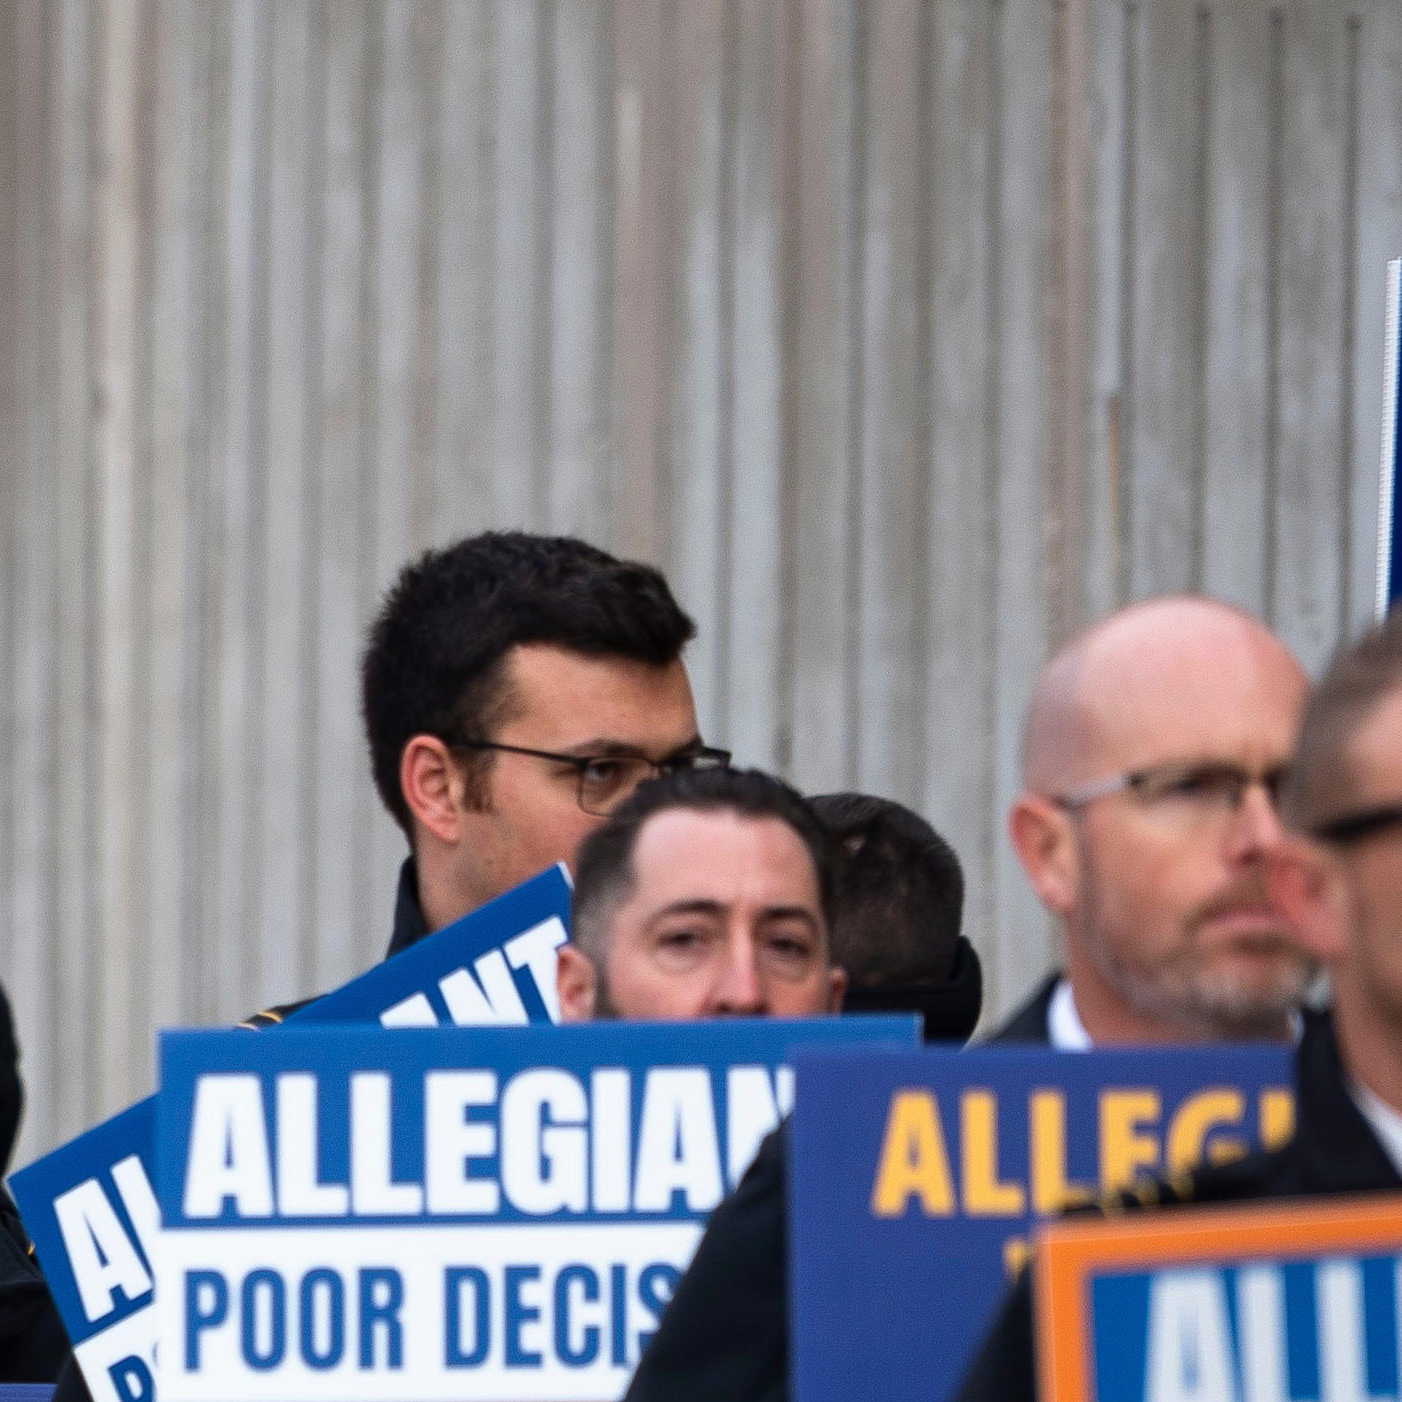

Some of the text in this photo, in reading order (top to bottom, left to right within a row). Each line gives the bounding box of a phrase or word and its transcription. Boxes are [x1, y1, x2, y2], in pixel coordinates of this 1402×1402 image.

[182, 1065, 796, 1219] ALLEGIAN
[182, 1262, 684, 1375] POOR DECIS
